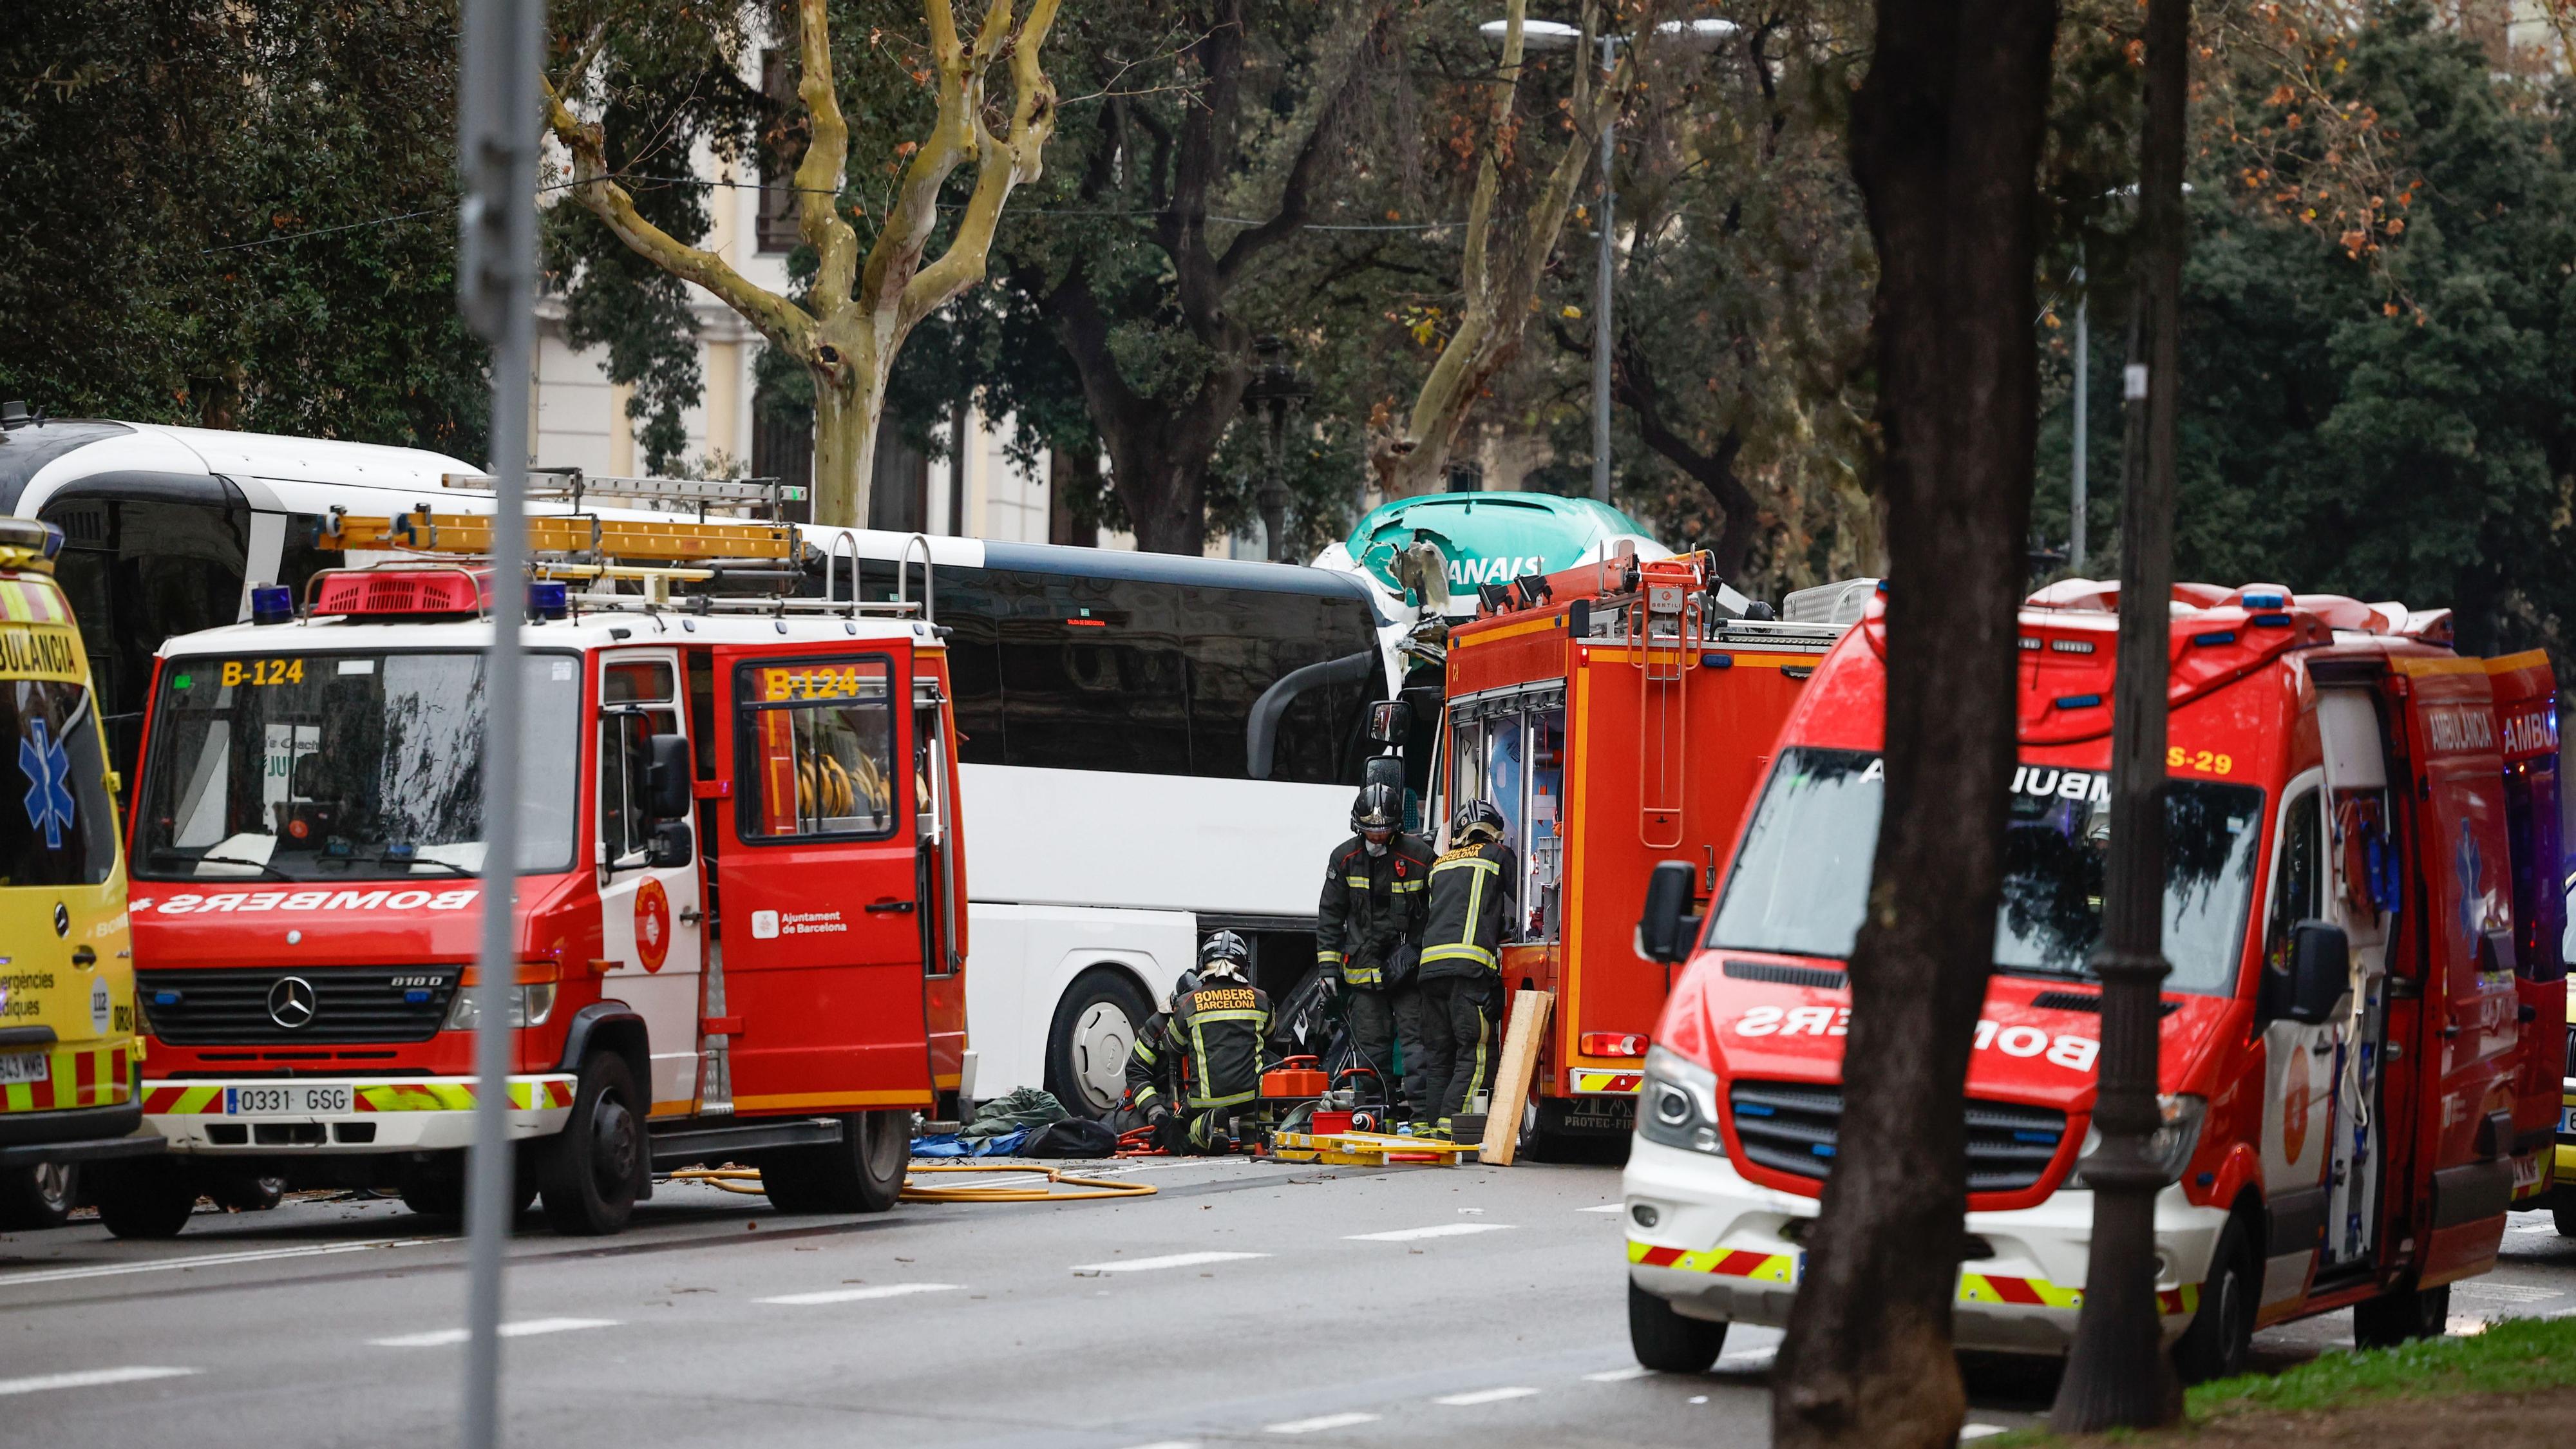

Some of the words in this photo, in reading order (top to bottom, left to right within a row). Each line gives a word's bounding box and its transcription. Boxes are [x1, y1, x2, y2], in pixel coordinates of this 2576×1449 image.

[222, 659, 305, 687] B-124
[766, 667, 860, 701] B-124
[2166, 746, 2232, 775] S-29
[782, 911, 840, 923] Ajuntament
[782, 924, 795, 934] de
[797, 923, 847, 934] Barcelona
[1194, 989, 1255, 1004] BOMBERS
[1196, 999, 1256, 1012] BARCELONA
[242, 1090, 289, 1111] 0331
[307, 1090, 345, 1110] GSG
